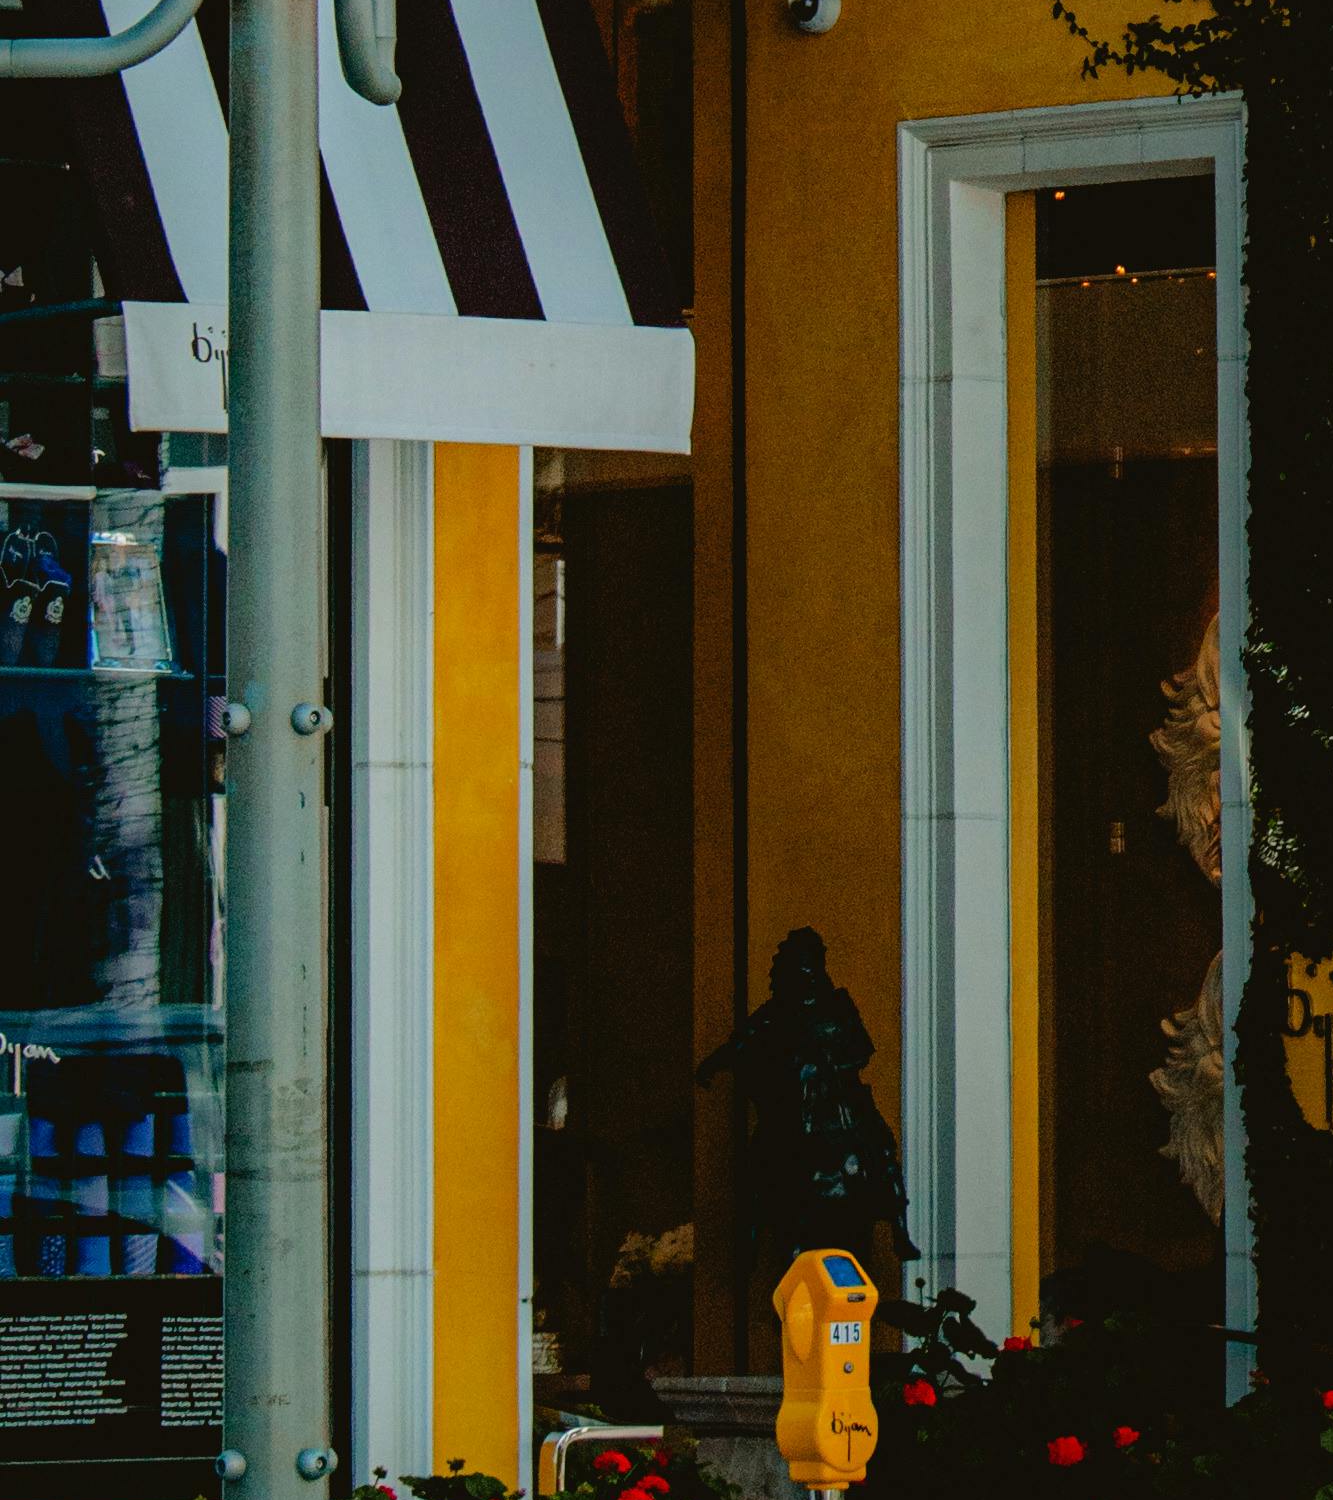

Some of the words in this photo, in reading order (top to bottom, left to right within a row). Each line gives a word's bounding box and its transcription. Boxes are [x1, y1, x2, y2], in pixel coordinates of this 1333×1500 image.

[191, 322, 229, 413] bij
[832, 1323, 860, 1343] 415
[831, 1411, 872, 1463] bijan
